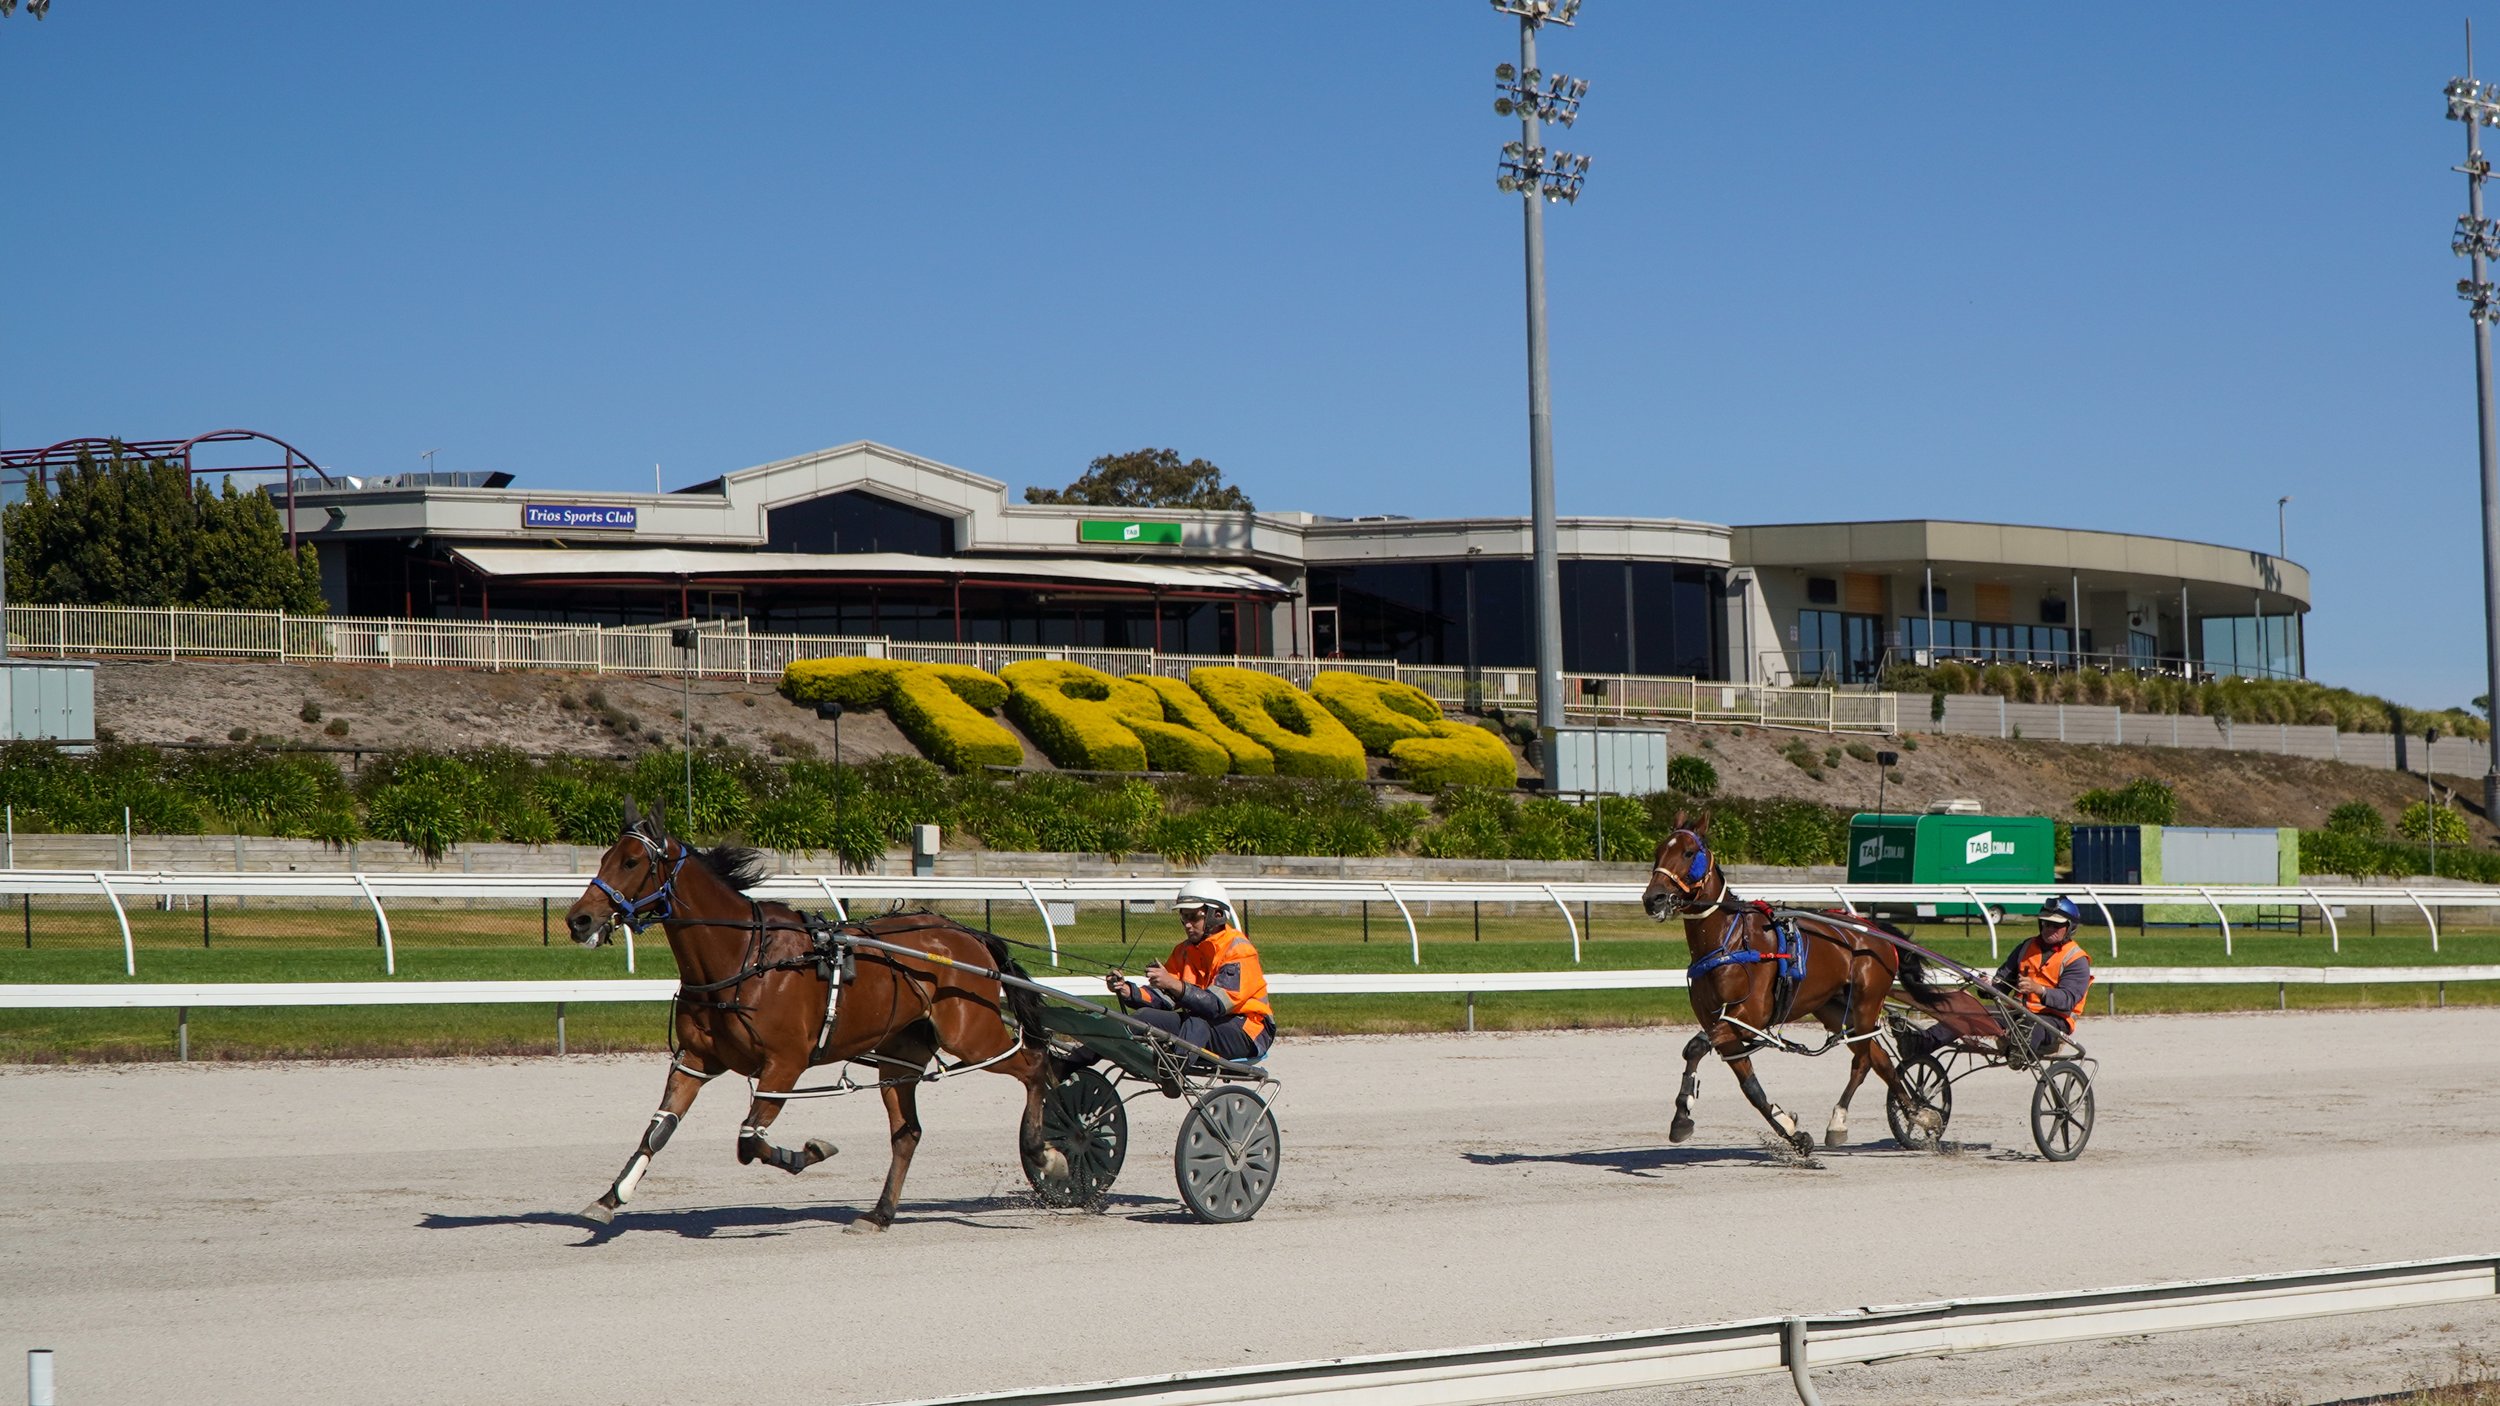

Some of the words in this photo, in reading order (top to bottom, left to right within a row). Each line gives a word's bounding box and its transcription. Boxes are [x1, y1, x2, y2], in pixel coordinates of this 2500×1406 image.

[529, 509, 561, 522] Trios
[564, 510, 603, 525] Sports
[606, 511, 634, 523] Club
[781, 656, 1518, 793] TRIOS
